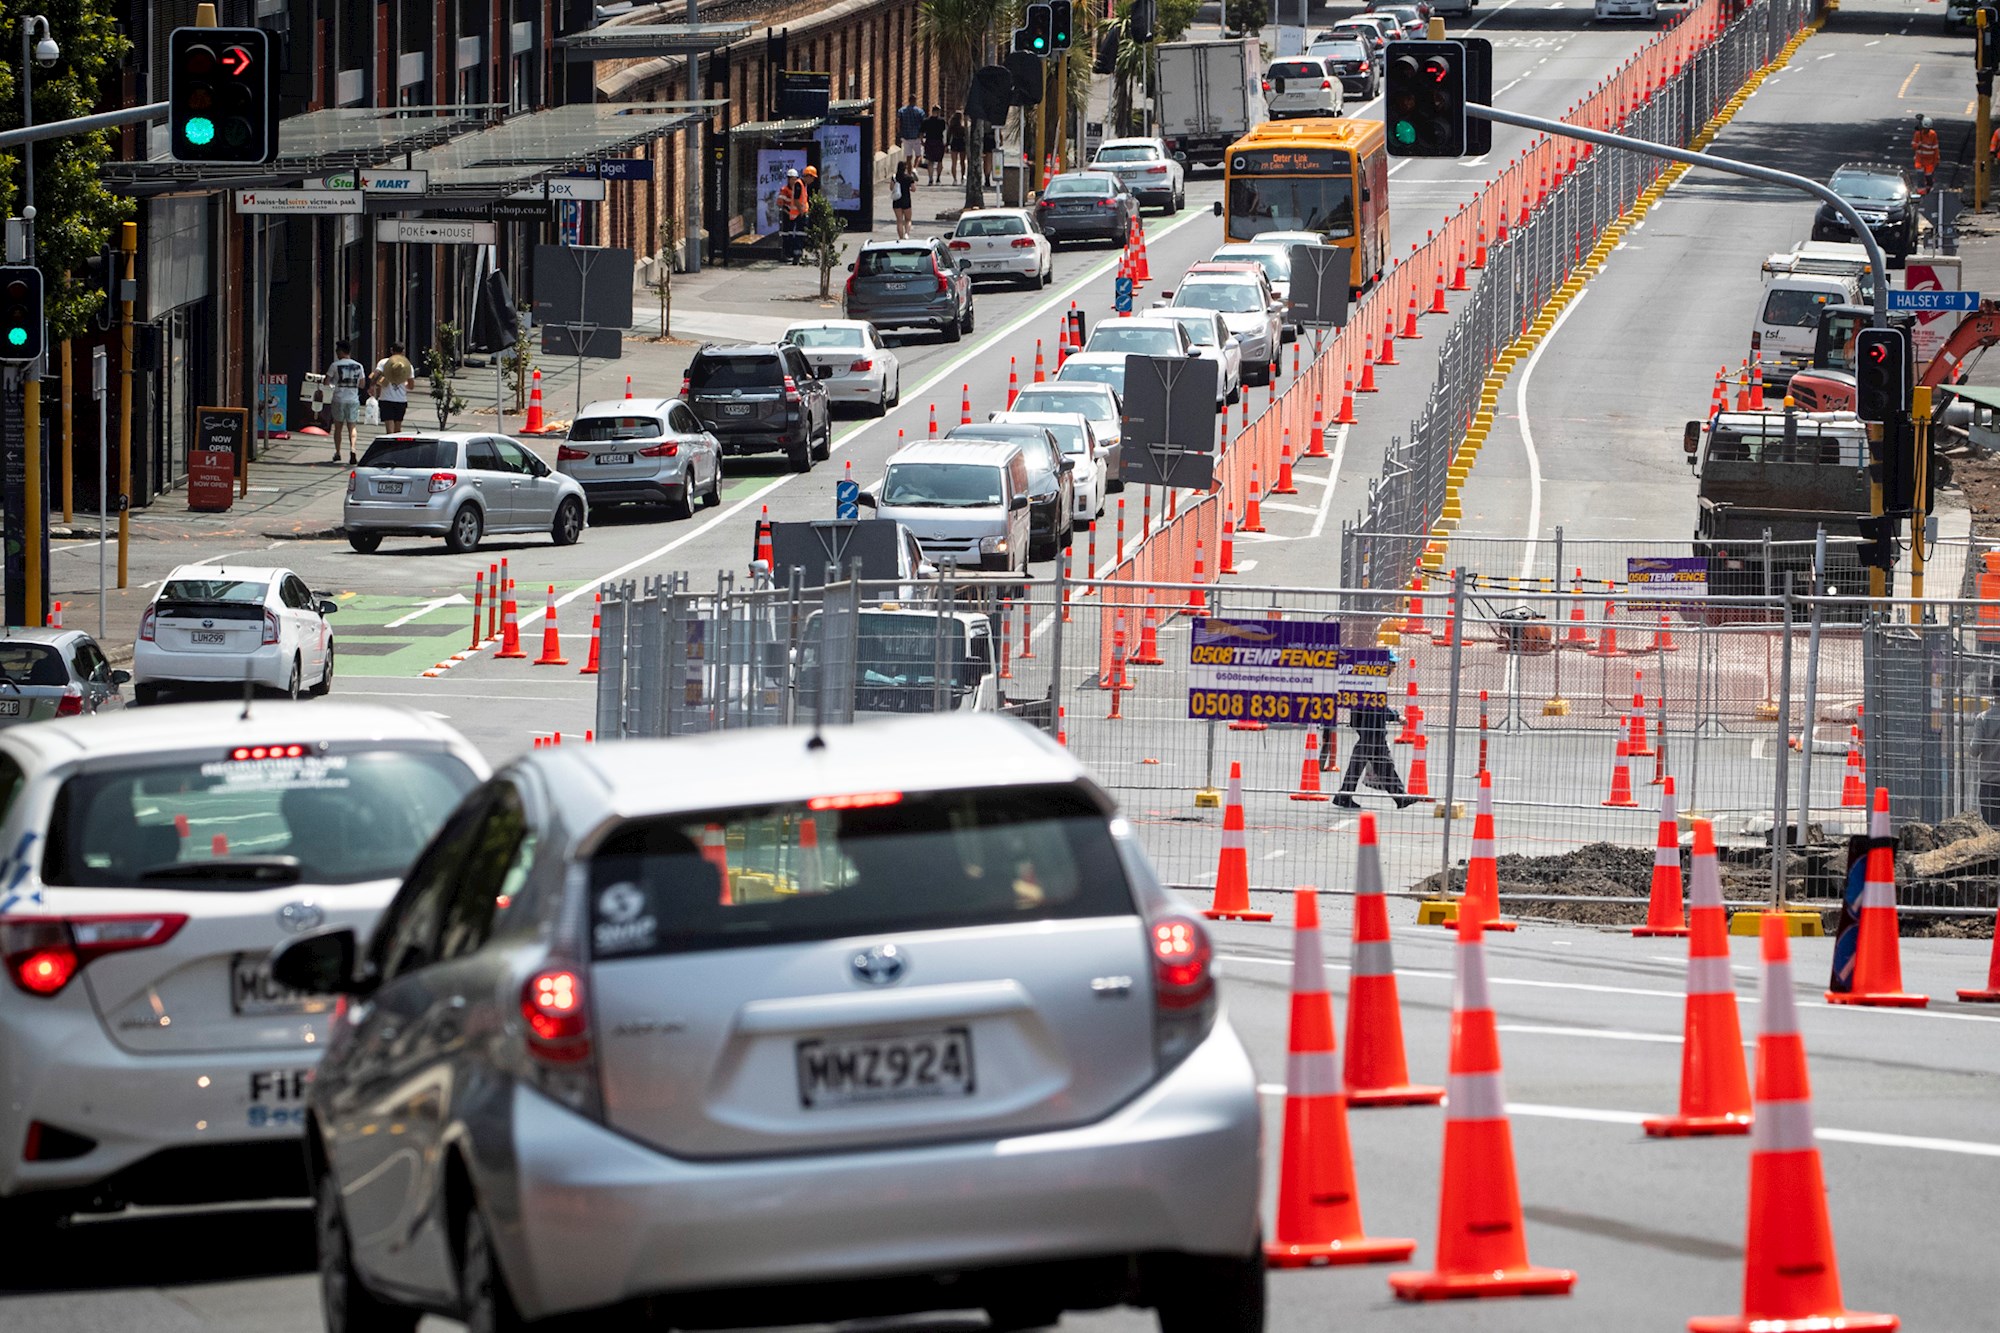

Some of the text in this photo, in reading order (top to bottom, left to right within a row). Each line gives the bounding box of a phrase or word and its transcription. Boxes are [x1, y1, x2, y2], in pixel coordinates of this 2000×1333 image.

[1294, 153, 1308, 162] Link
[333, 178, 411, 189] Sta MART
[400, 225, 472, 238] POKÉ HOUSE
[1896, 295, 1955, 308] HALSEY ST
[210, 435, 232, 443] NOW
[209, 444, 232, 453] OPEN
[200, 474, 222, 482] HOTEL
[210, 481, 228, 489] OPEN
[192, 632, 225, 643] LUH299
[1288, 642, 1305, 650] HIRE
[1313, 643, 1339, 651] SALES
[1191, 645, 1338, 668] 0508TEMPFENCE
[1215, 672, 1314, 685] 0508tempfence.co.nz
[1191, 692, 1336, 720] 0508 836 733
[1362, 693, 1387, 708] 733
[808, 1042, 964, 1090] MMZ924
